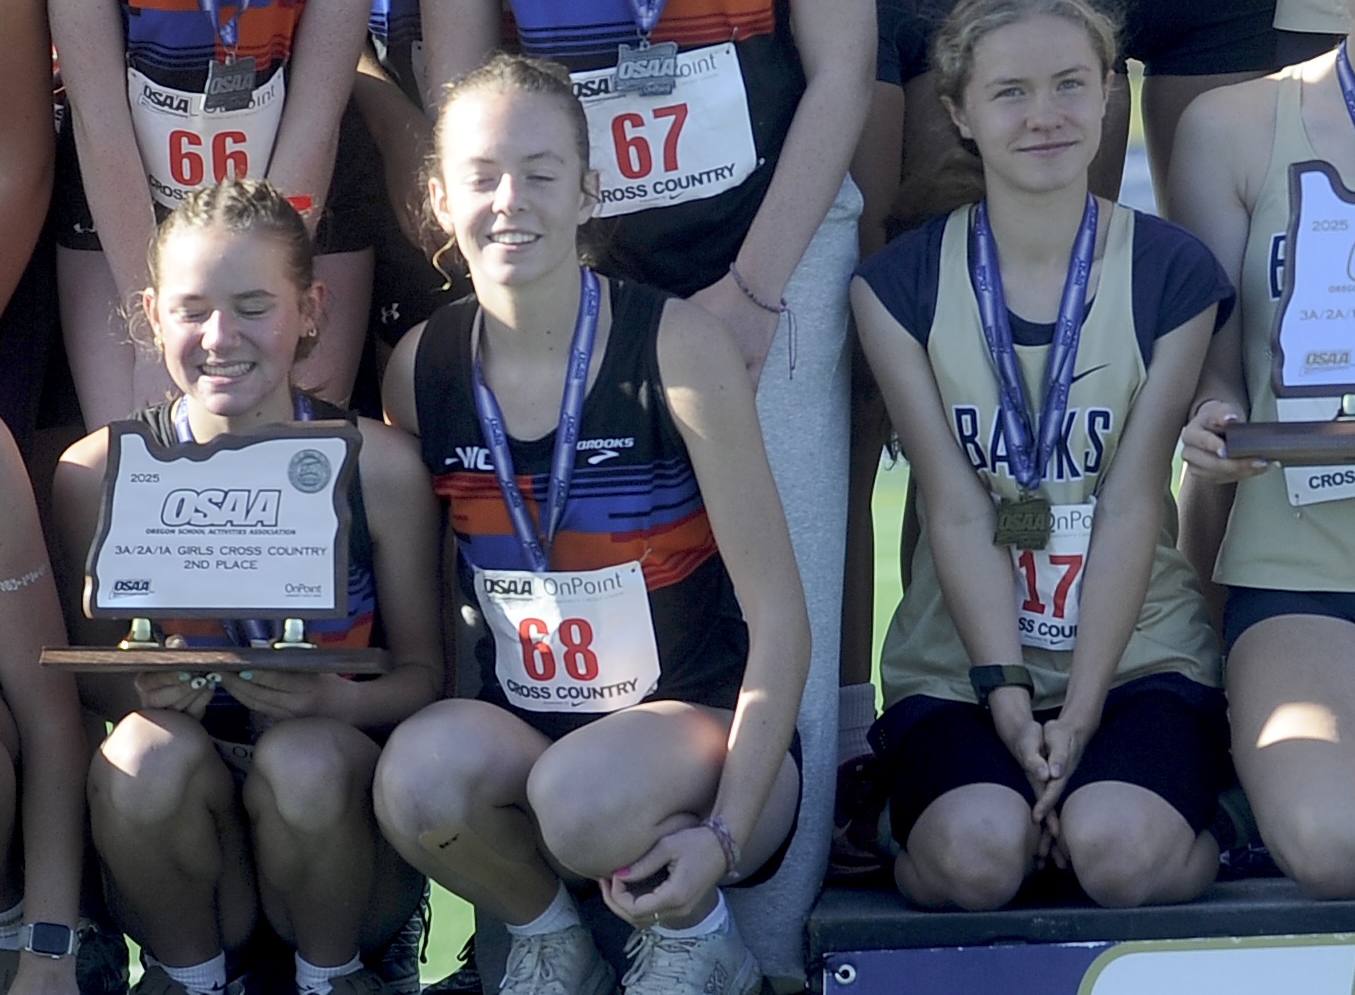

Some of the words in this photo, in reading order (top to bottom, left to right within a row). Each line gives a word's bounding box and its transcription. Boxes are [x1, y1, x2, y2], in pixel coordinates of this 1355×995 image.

[573, 77, 612, 98] OSA
[677, 53, 717, 78] oint
[618, 58, 676, 80] OSAA
[143, 84, 190, 114] OSAA
[611, 102, 689, 181] 67
[168, 129, 249, 187] 66
[149, 174, 193, 201] CROS
[600, 184, 648, 204] ROSS
[652, 163, 736, 195] COUNTRY
[1312, 220, 1349, 232] 2025
[575, 436, 635, 451] BROOKS
[954, 408, 1111, 480] BAKS
[130, 473, 160, 483] 2025
[161, 488, 283, 528] OSAA
[115, 545, 172, 555] 3A/2A/1A
[177, 545, 215, 556] GIRLS
[219, 545, 263, 556] CROSS
[267, 545, 328, 556] COUNTRY
[183, 560, 210, 570] 2ND
[215, 560, 259, 570] PLACE
[114, 580, 150, 592] OSAA
[284, 583, 322, 594] OnPoint
[484, 578, 533, 596] OSAA
[543, 571, 623, 597] OnPoint
[1018, 550, 1084, 620] 17
[519, 617, 600, 682] 68
[506, 678, 552, 700] CROSS
[556, 677, 639, 700] COUNTRY
